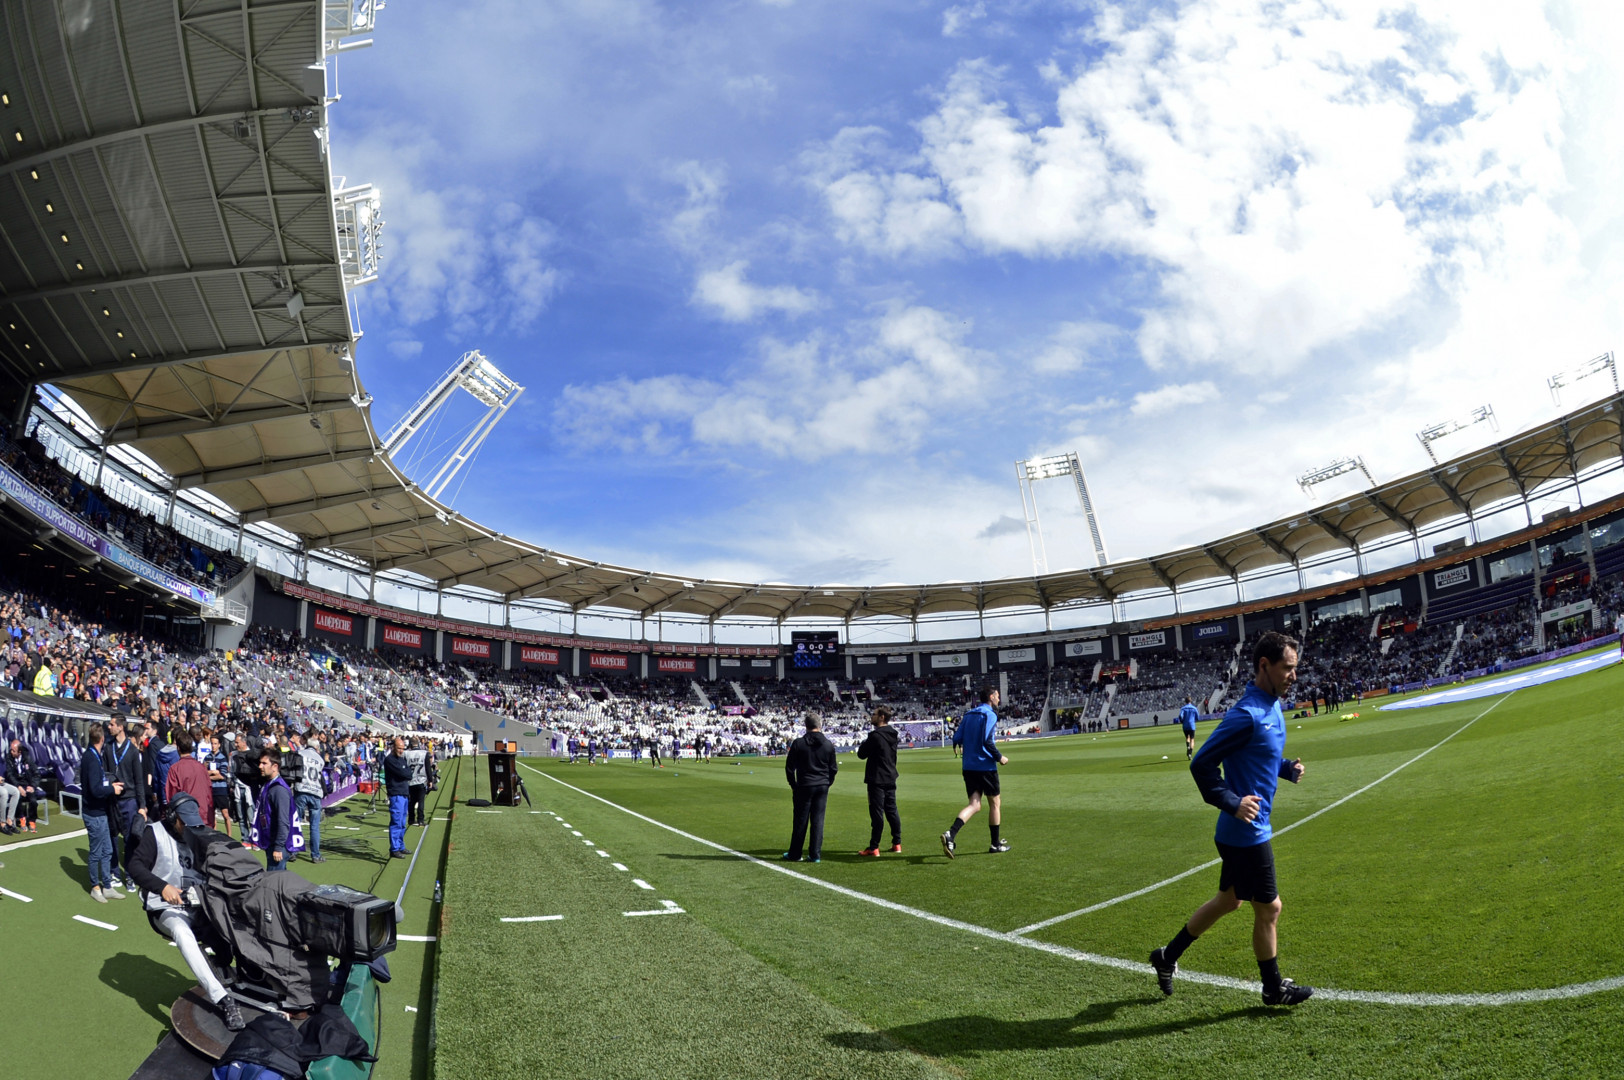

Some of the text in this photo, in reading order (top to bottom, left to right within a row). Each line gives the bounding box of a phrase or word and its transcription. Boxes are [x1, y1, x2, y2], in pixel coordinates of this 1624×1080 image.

[0, 470, 98, 548] PARTENAIRE ET SUPPORTER DU TFC
[118, 553, 192, 596] BANQUE POPULAIRE OCCITANE
